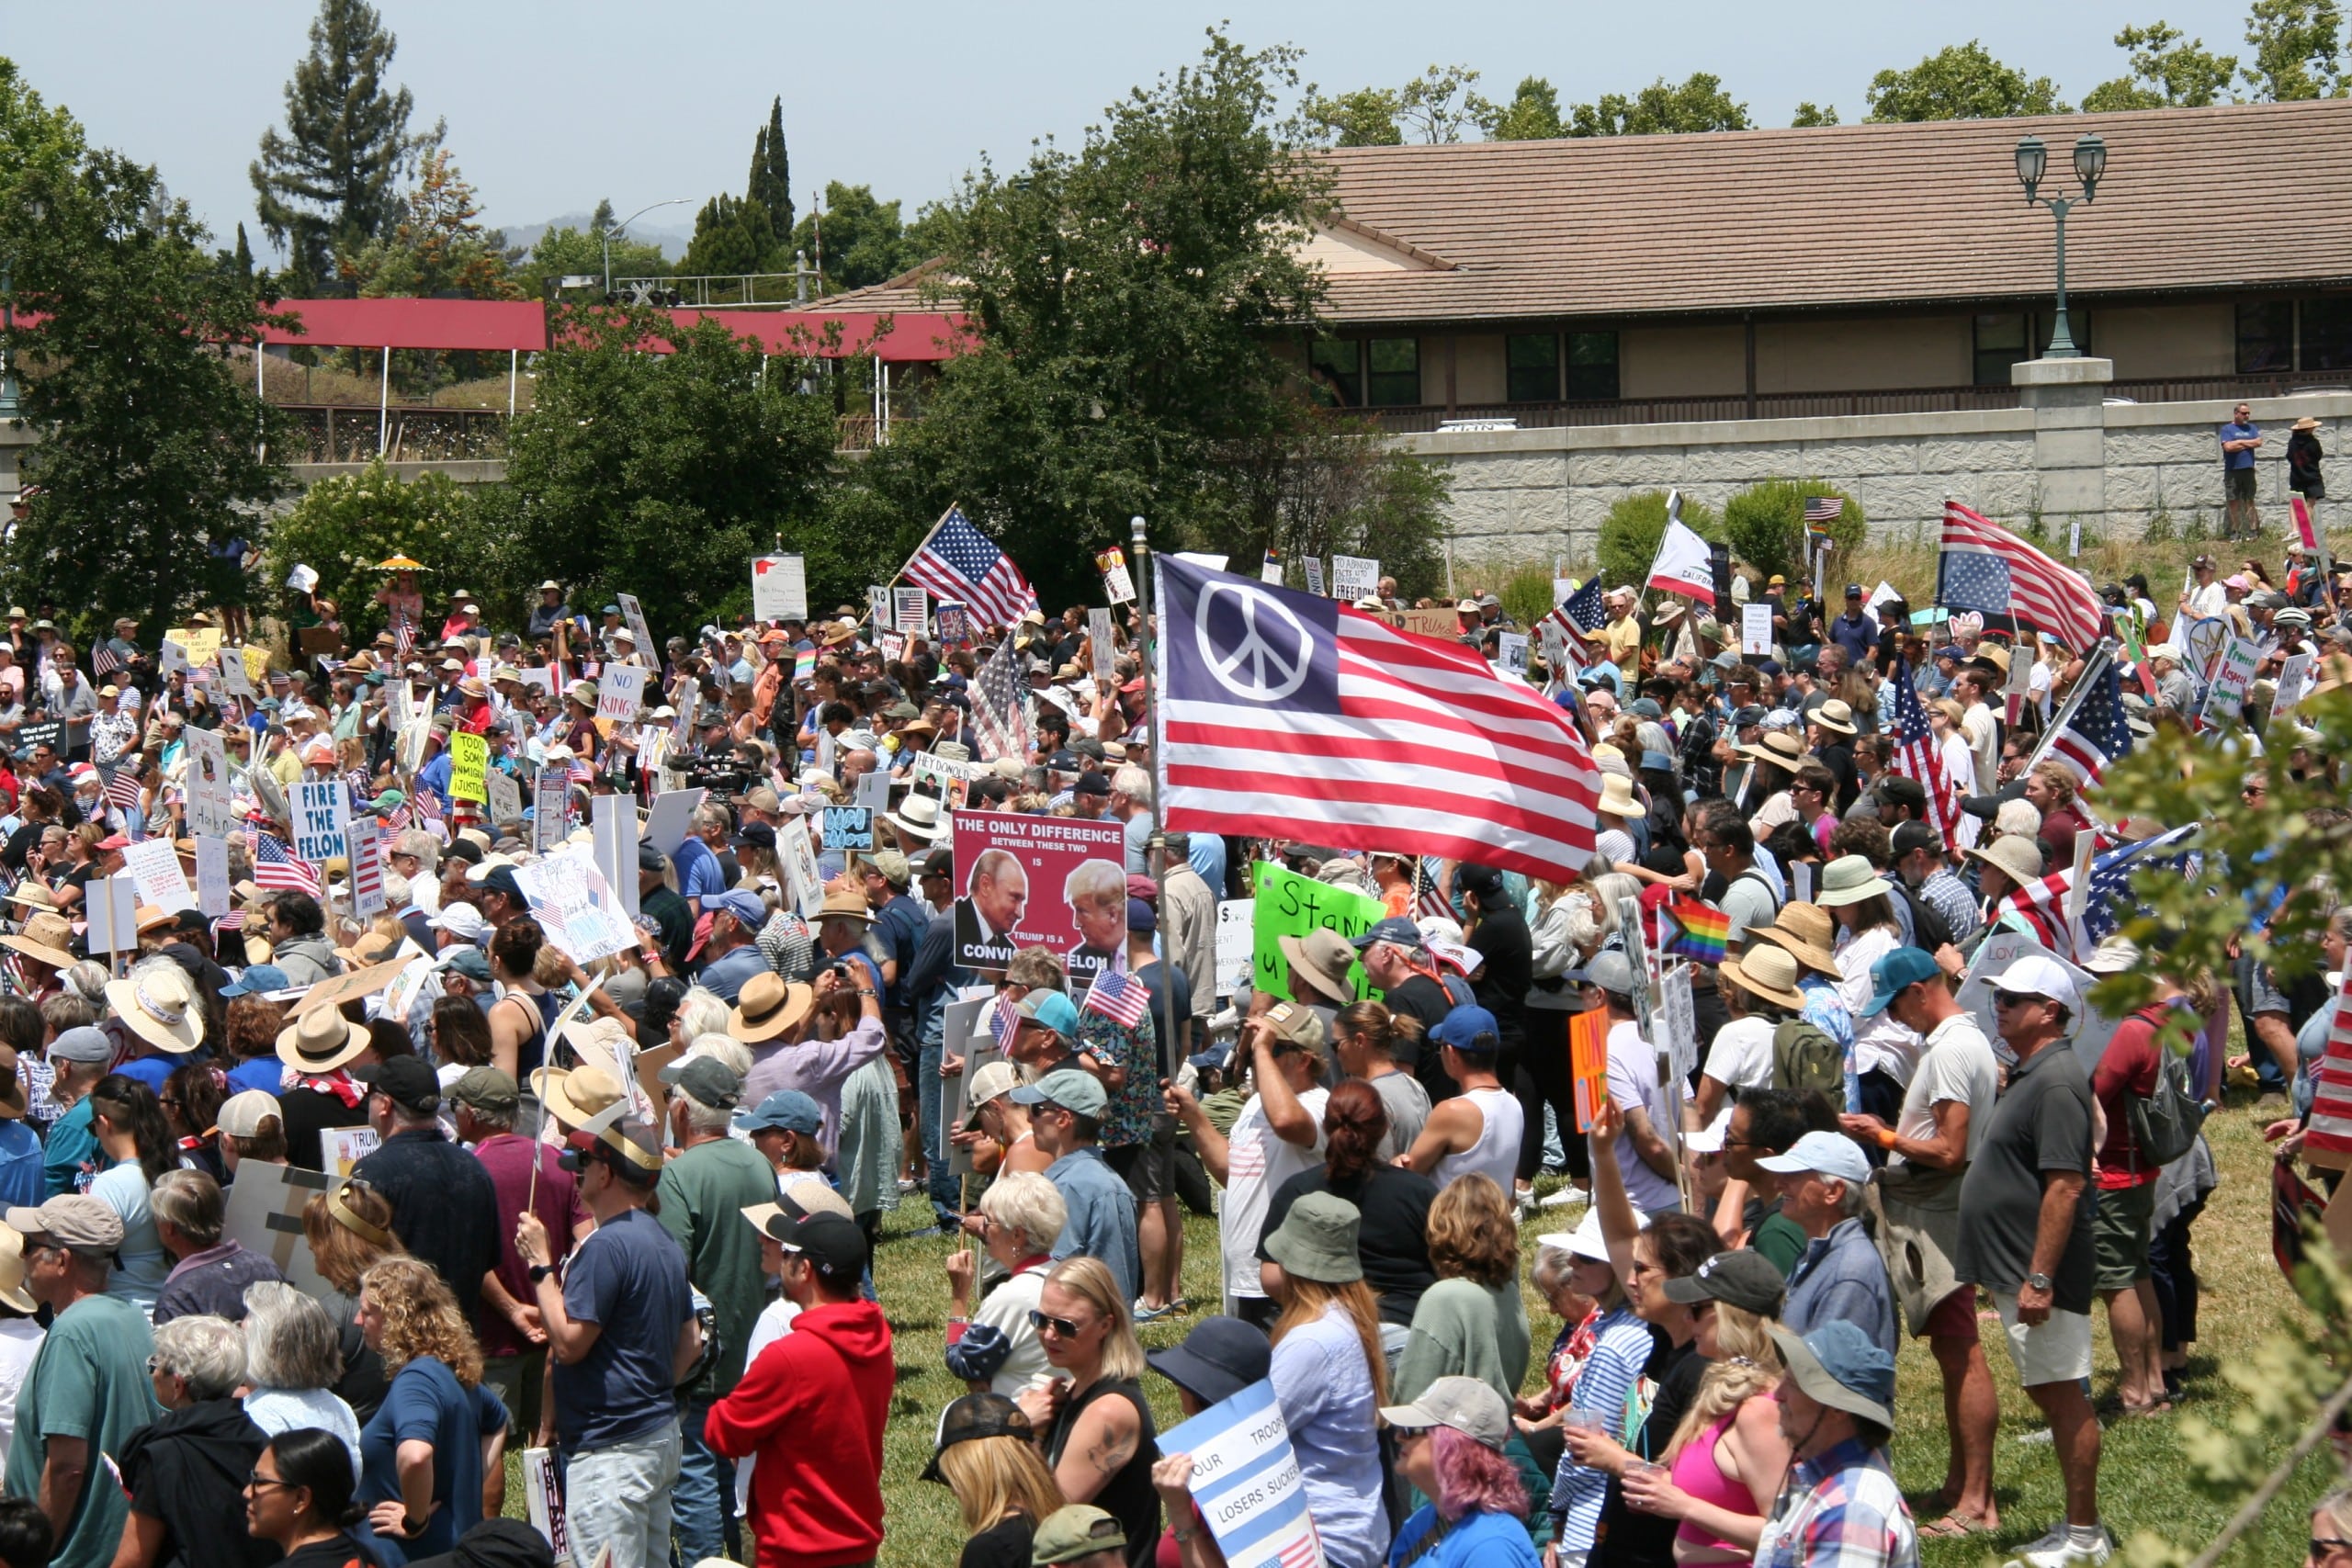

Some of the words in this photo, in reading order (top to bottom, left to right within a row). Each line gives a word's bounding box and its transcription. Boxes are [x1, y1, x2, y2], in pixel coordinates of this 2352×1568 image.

[873, 590, 887, 603] NO
[611, 672, 633, 690] NO
[599, 693, 639, 716] KINGS
[19, 727, 38, 736] What
[38, 723, 51, 733] will
[51, 722, 61, 730] be
[22, 735, 35, 743] left
[917, 753, 936, 770] HEY
[935, 759, 970, 782] DONOLD
[301, 783, 338, 808] FIRE
[305, 808, 335, 833] THE
[955, 818, 986, 833] THE
[989, 820, 1028, 837] ONLY
[1031, 824, 1122, 844] DIFFERENCE
[298, 833, 345, 860] FELON
[990, 837, 1035, 849] BETWEEN
[1035, 840, 1066, 852] THESE
[1067, 843, 1088, 853] TWO
[1032, 857, 1043, 867] IS
[1013, 931, 1045, 942] TRUMP
[1046, 934, 1056, 943] IS
[1057, 935, 1065, 944] A
[1987, 944, 2026, 961] LOVE
[1992, 1035, 2014, 1055] FOR
[352, 1131, 381, 1148] TRUM
[1193, 1452, 1224, 1477] OUR
[1217, 1488, 1264, 1524] LOSERS
